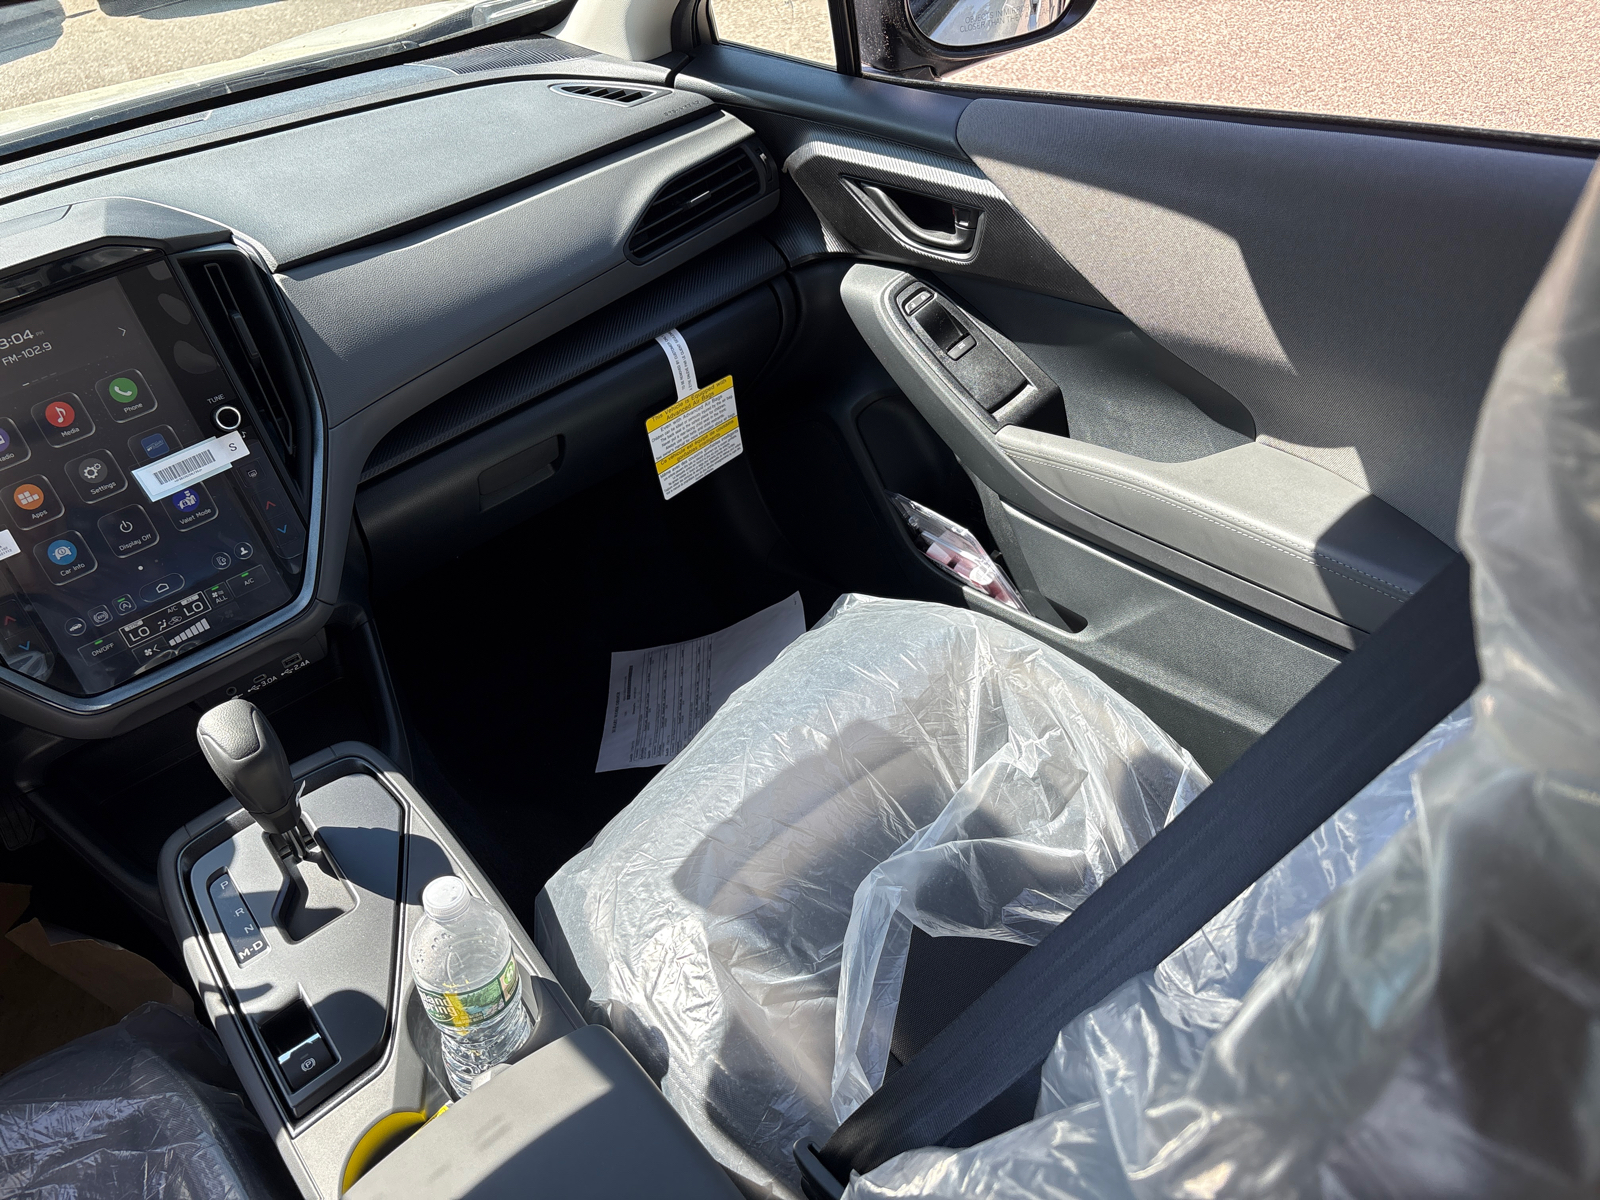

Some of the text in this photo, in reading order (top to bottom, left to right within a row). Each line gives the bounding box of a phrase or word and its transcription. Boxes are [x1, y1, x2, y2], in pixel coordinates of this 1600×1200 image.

[965, 12, 994, 24] OBJECTS
[960, 21, 986, 32] CLOSER
[989, 18, 1004, 26] THAN
[2, 342, 52, 366] FM-102.9
[207, 394, 225, 404] TUNE
[651, 413, 663, 422] This
[665, 402, 683, 414] Vehicle
[691, 385, 714, 400] Equipped
[124, 403, 143, 413] Phone
[667, 404, 691, 420] Advanced
[702, 392, 714, 401] Bags
[61, 427, 80, 437] Media
[228, 443, 238, 452] S
[0, 452, 15, 462] adio
[90, 482, 116, 495] Settings
[32, 510, 48, 520] Apps
[179, 508, 212, 525] Valet Mode
[119, 539, 141, 551] Display
[244, 578, 254, 586] A/C
[184, 601, 204, 616] LO
[129, 626, 150, 641] LO
[92, 643, 114, 656] ON/OFF
[294, 660, 310, 670] 2.4A
[261, 676, 277, 686] 3.0A
[220, 880, 229, 889] P
[235, 908, 245, 916] R
[244, 924, 254, 934] N
[238, 940, 263, 960] M-D
